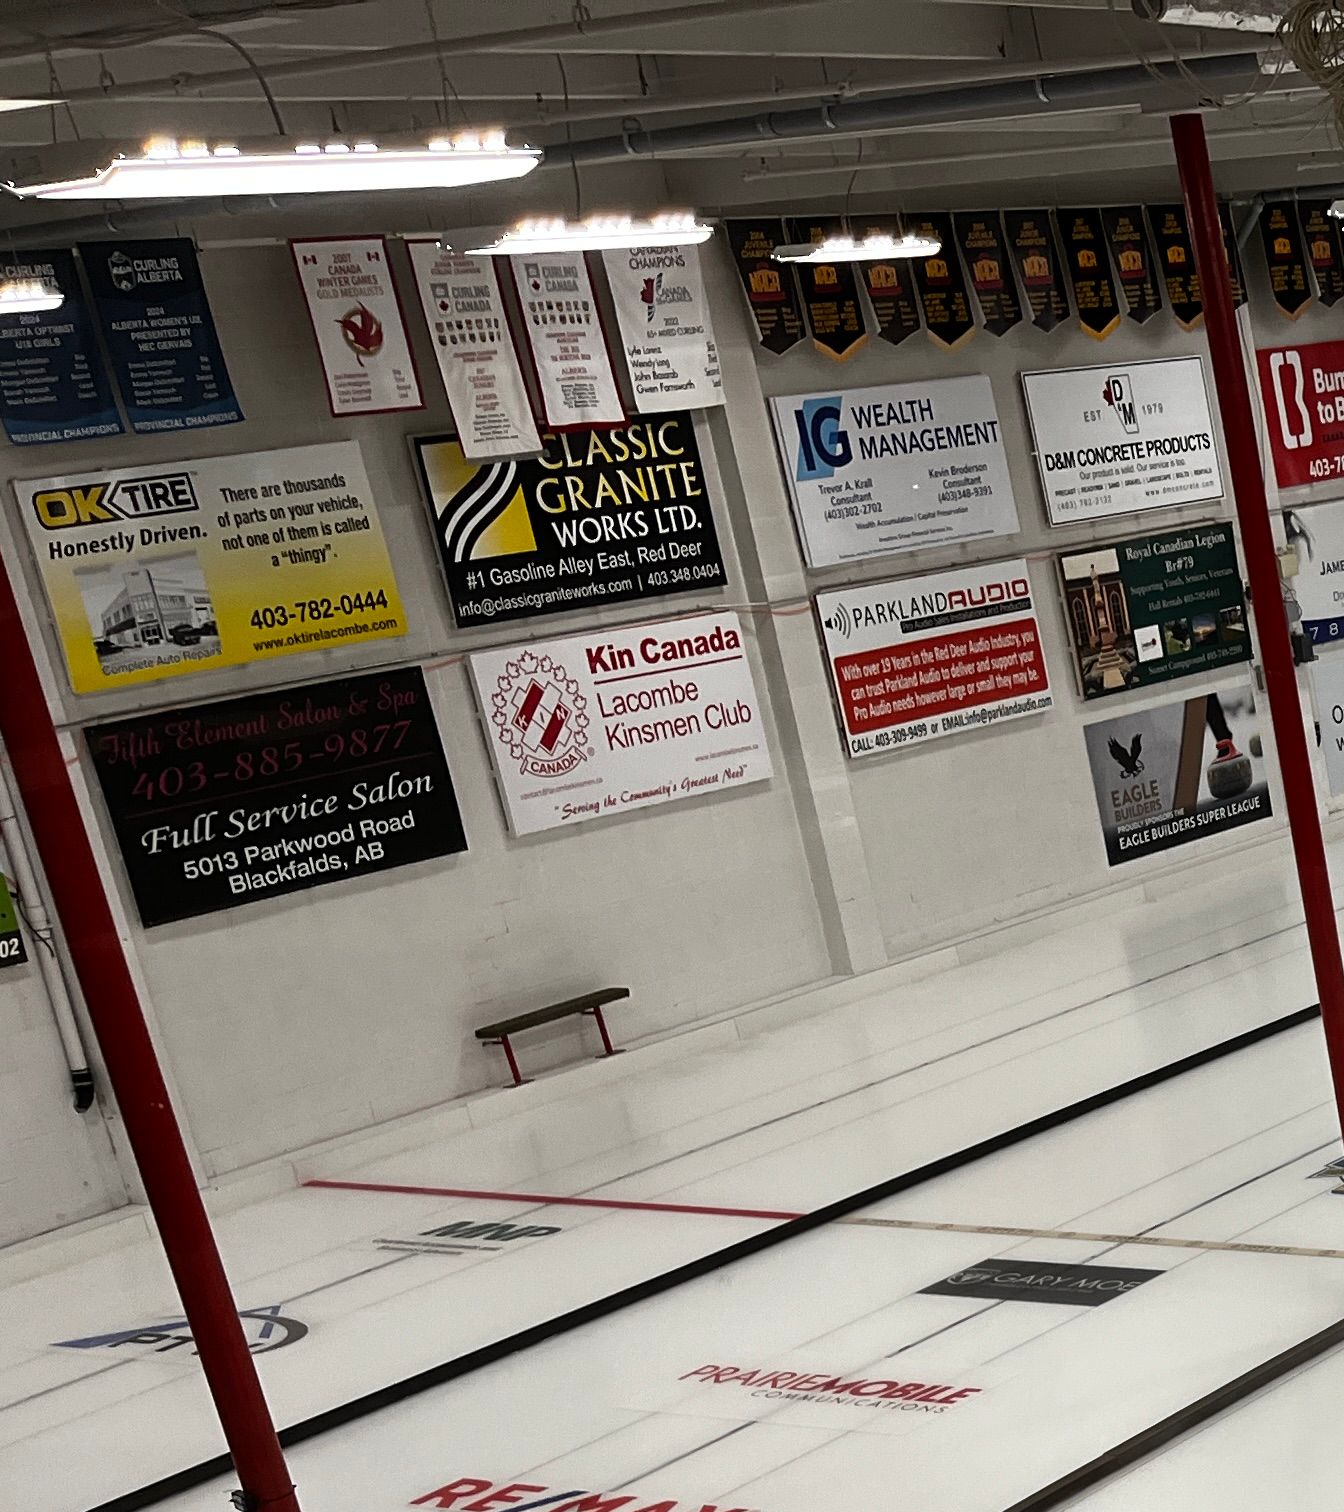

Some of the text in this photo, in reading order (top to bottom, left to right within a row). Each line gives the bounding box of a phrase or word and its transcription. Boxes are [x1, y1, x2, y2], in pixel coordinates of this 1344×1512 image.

[134, 258, 179, 270] CURLING
[327, 265, 362, 275] CANADA
[543, 265, 578, 279] CURLING
[452, 285, 491, 299] CURLING
[546, 280, 578, 292] CANADA
[456, 300, 491, 312] CANADA
[851, 399, 934, 429] WEALTH
[1317, 403, 1334, 424] to
[537, 421, 684, 469] CLASSIC
[794, 406, 853, 472] IG
[859, 421, 998, 460] MANAGEMENT
[1045, 433, 1210, 471] D&M CONCRETE PRODUCTS
[35, 476, 192, 528] OK TIRE
[536, 462, 702, 514] GRANITE
[831, 492, 871, 507] Consultant
[49, 524, 208, 560] Honestly Driven.
[551, 505, 702, 548] WORKS LTD.
[1125, 531, 1226, 562] Royal Canadian Legion
[467, 541, 702, 591] #1 Gasoline Alley East, Red Deer
[459, 563, 721, 617] info@classicgraniteworks.com 403.348.0404
[251, 590, 389, 630] 403-782-0444
[253, 617, 397, 652] www.oktirelacombe.com
[585, 626, 740, 675] Kin Canada
[597, 679, 698, 719] Lacombe
[101, 682, 416, 772] Fifth Element Salon Spa
[604, 699, 751, 751] Kinsmen Club
[132, 719, 412, 801] 403-885-9877
[531, 754, 578, 774] CANADA
[142, 771, 434, 856] Full Service Salon
[1111, 780, 1159, 809] EAGLE
[1114, 798, 1162, 823] BUILDERS
[1119, 796, 1260, 850] EAGLE BUILDERS SUPER LEAGUE
[184, 811, 415, 880] 5013 Parkwood Road
[229, 842, 384, 895] Blackfalds, AB
[420, 1218, 564, 1242] MNP
[994, 1273, 1068, 1286] GARY
[1071, 1277, 1142, 1291] MOE
[751, 1389, 952, 1418] COMMUNICATIONS
